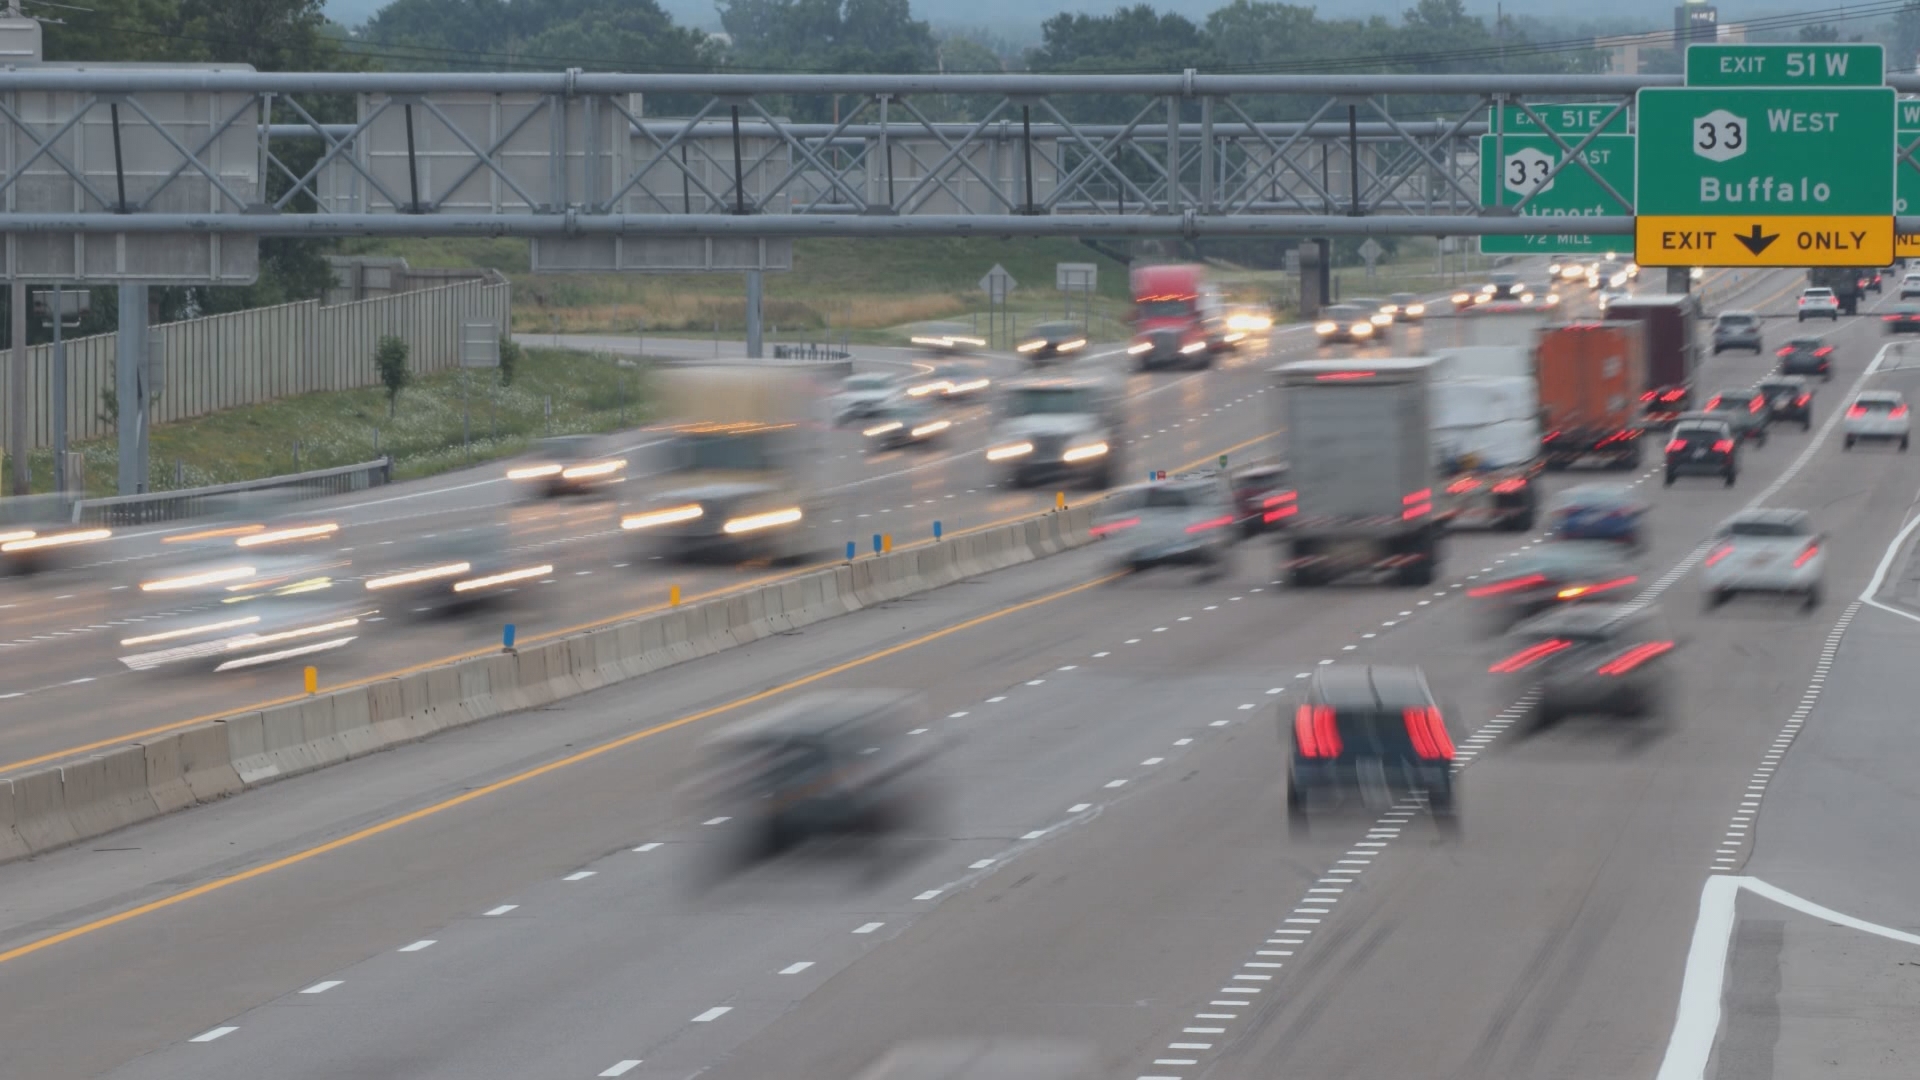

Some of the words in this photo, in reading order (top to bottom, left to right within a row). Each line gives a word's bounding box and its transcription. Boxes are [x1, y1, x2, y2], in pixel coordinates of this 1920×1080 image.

[1720, 56, 1766, 73] EXIT
[1767, 108, 1839, 132] WEST
[1698, 122, 1742, 150] 33
[1509, 159, 1549, 186] 33
[1700, 176, 1831, 202] Buffalo
[1557, 234, 1592, 245] MILE
[1662, 231, 1717, 250] EXIT
[1797, 231, 1867, 250] ONLY
